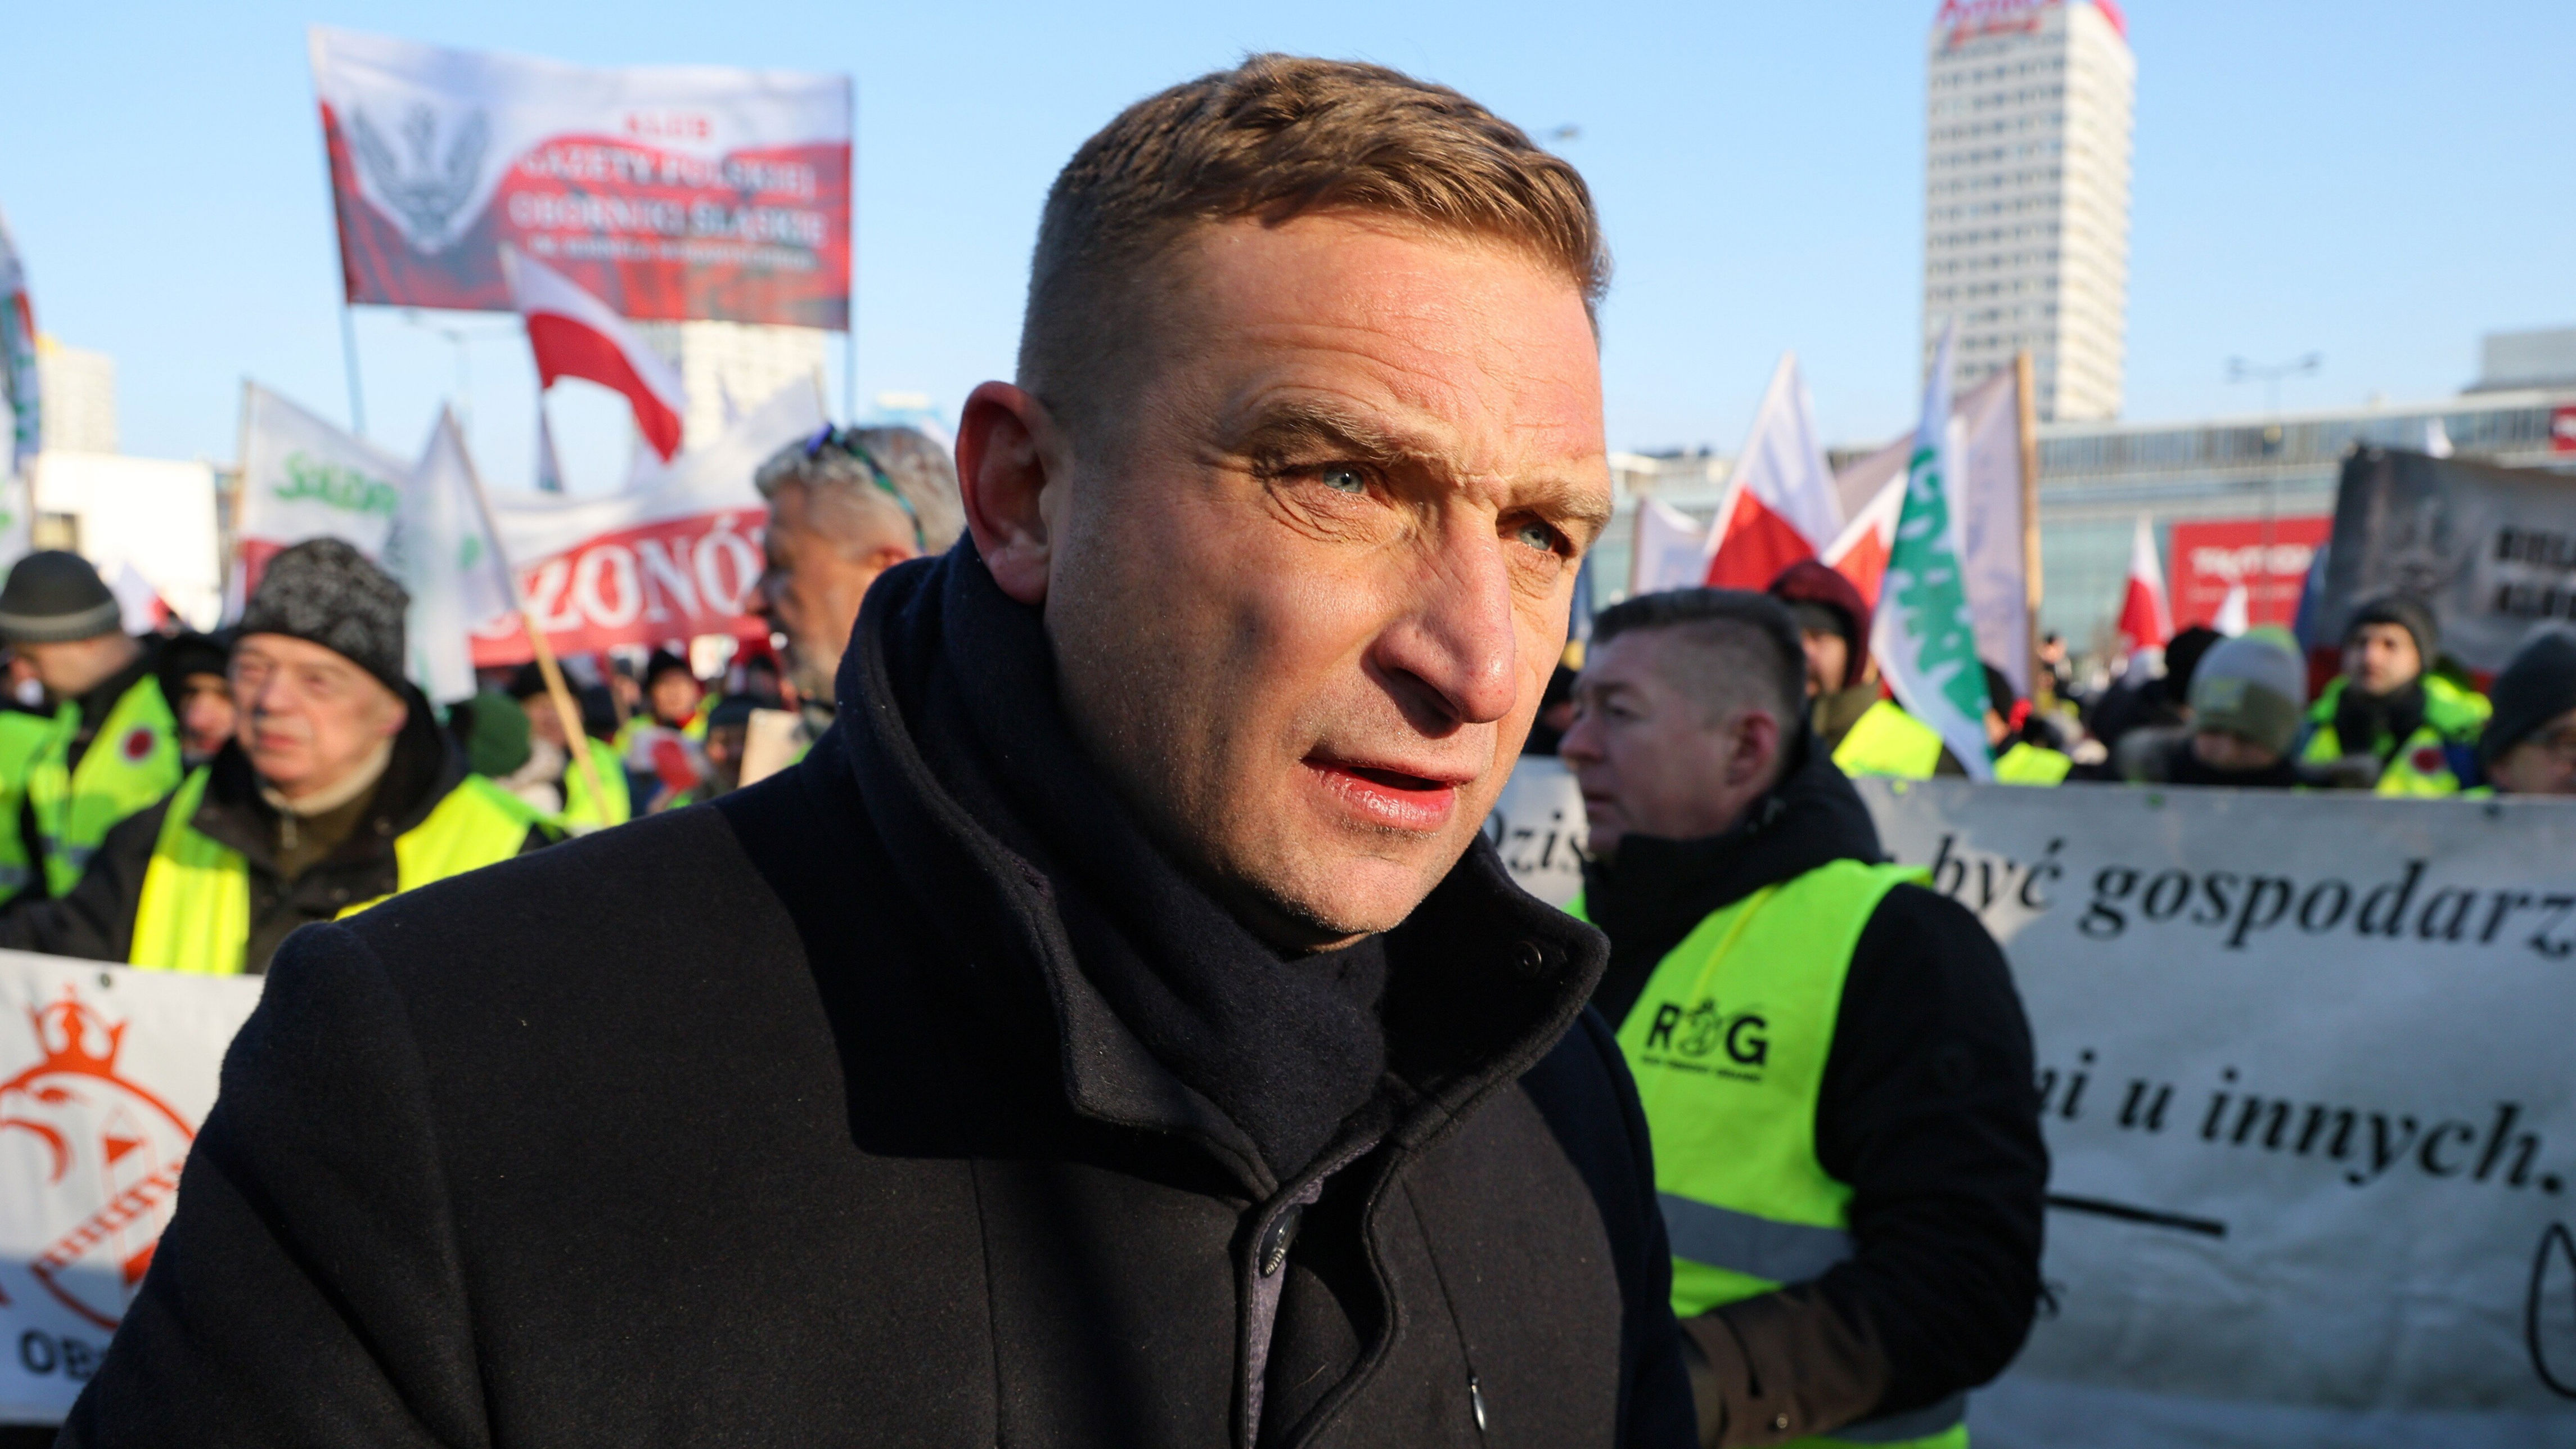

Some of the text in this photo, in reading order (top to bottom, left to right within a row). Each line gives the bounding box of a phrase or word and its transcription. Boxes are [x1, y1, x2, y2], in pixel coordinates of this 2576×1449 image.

[625, 115, 711, 142] KLUB
[1934, 832, 2065, 910] być
[2118, 1079, 2174, 1133] u
[2199, 1068, 2563, 1195] innych.
